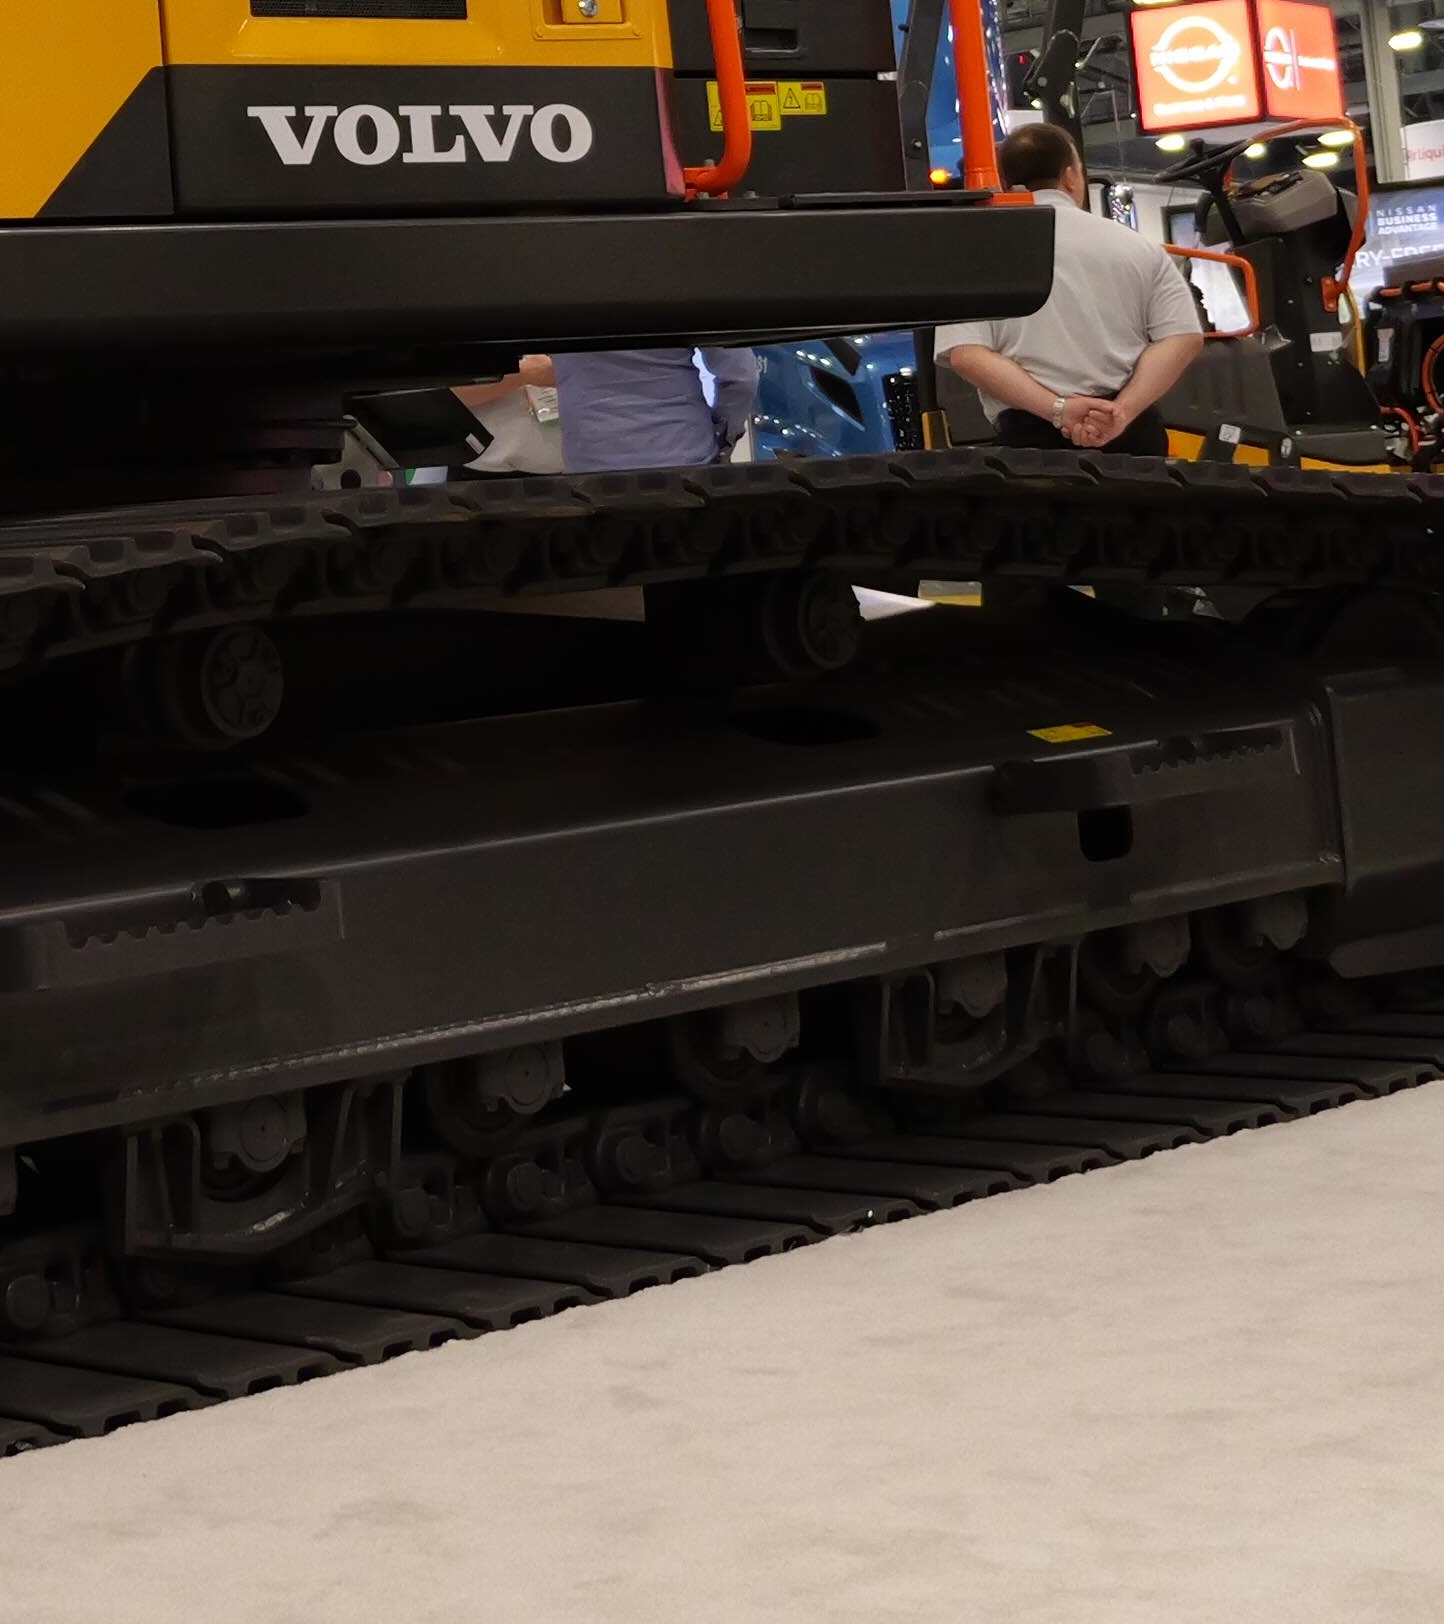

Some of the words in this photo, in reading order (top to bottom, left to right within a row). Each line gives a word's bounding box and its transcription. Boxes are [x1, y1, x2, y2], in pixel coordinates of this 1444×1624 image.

[247, 102, 594, 166] VOLVO
[1376, 204, 1437, 217] NISSAN
[1377, 212, 1439, 226] BUSINESS
[1378, 222, 1439, 235] ADVANTAGE
